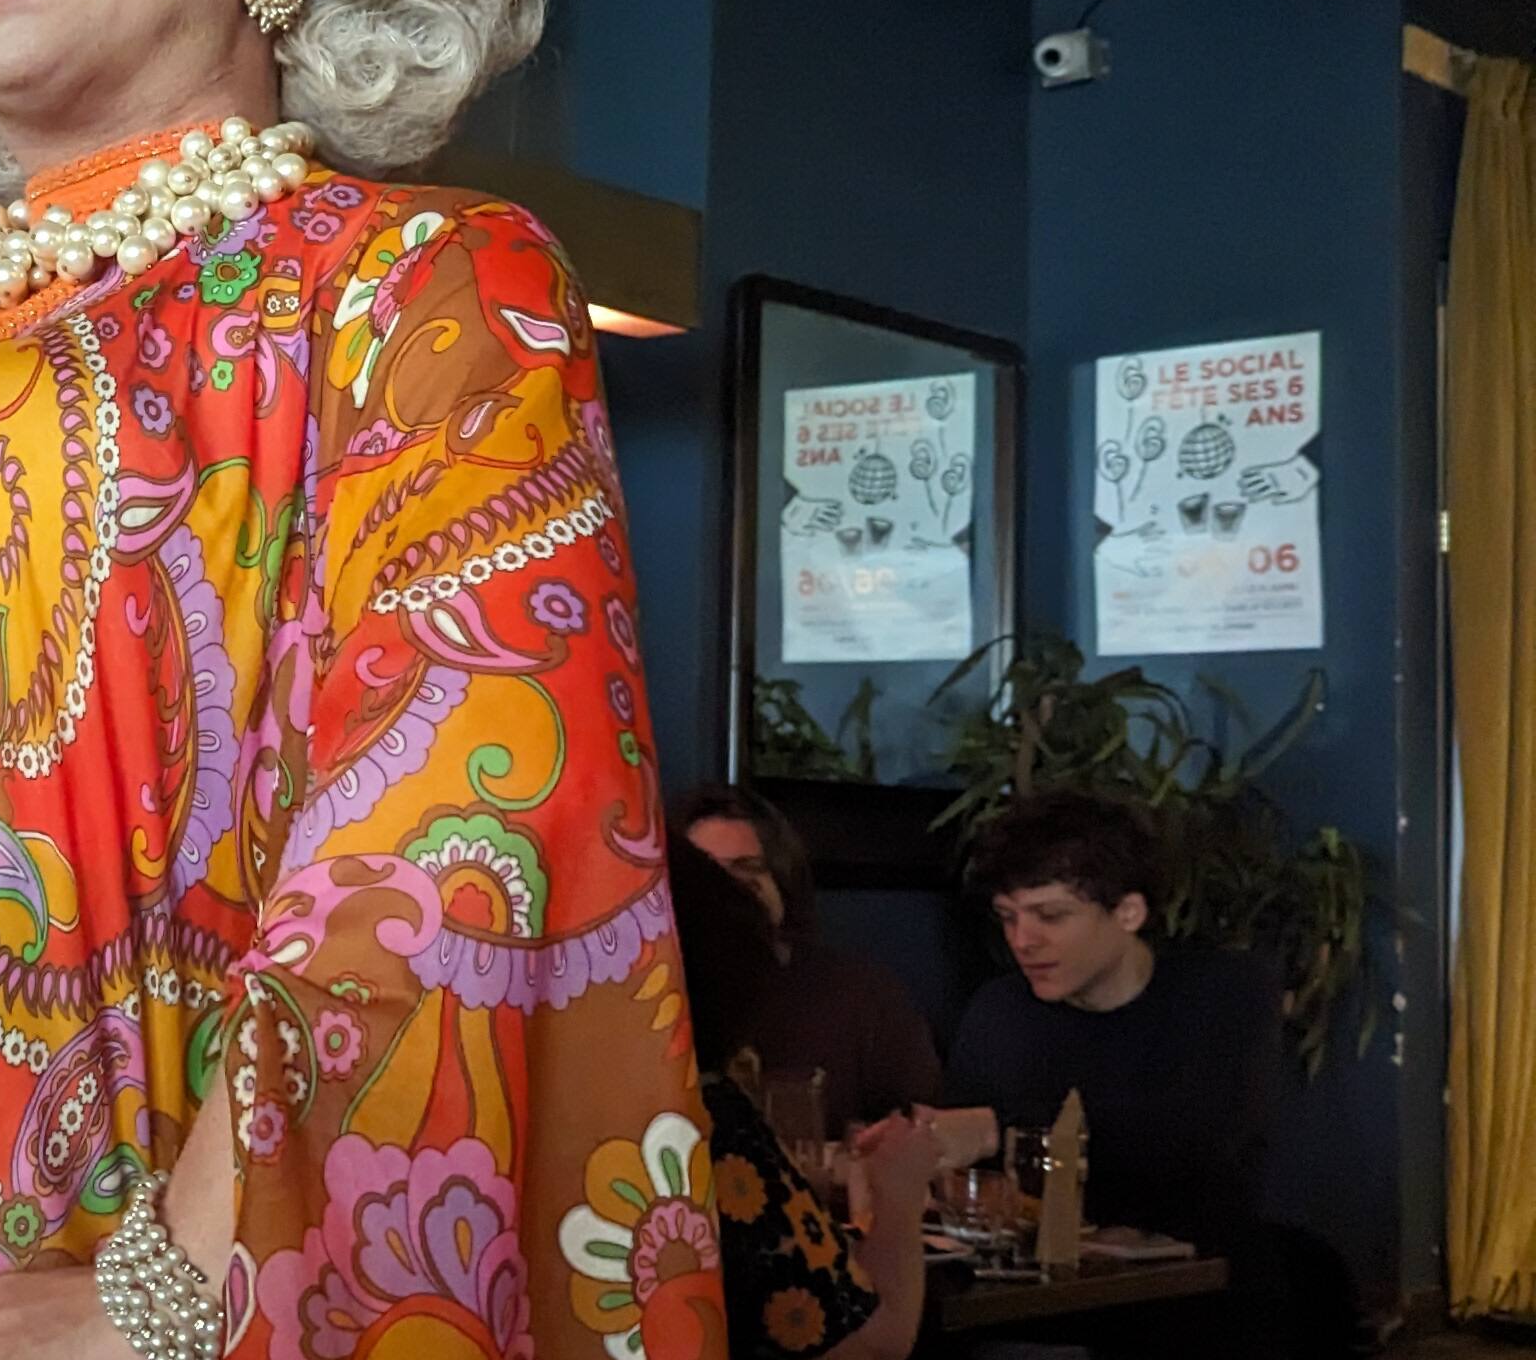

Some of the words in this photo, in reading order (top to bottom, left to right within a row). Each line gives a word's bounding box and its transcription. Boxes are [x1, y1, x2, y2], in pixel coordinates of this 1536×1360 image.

[1159, 363, 1190, 384] LE
[1200, 350, 1305, 380] SOCIAL
[1228, 378, 1277, 404] SES
[1287, 375, 1305, 397] 6
[1246, 403, 1305, 427] ANS
